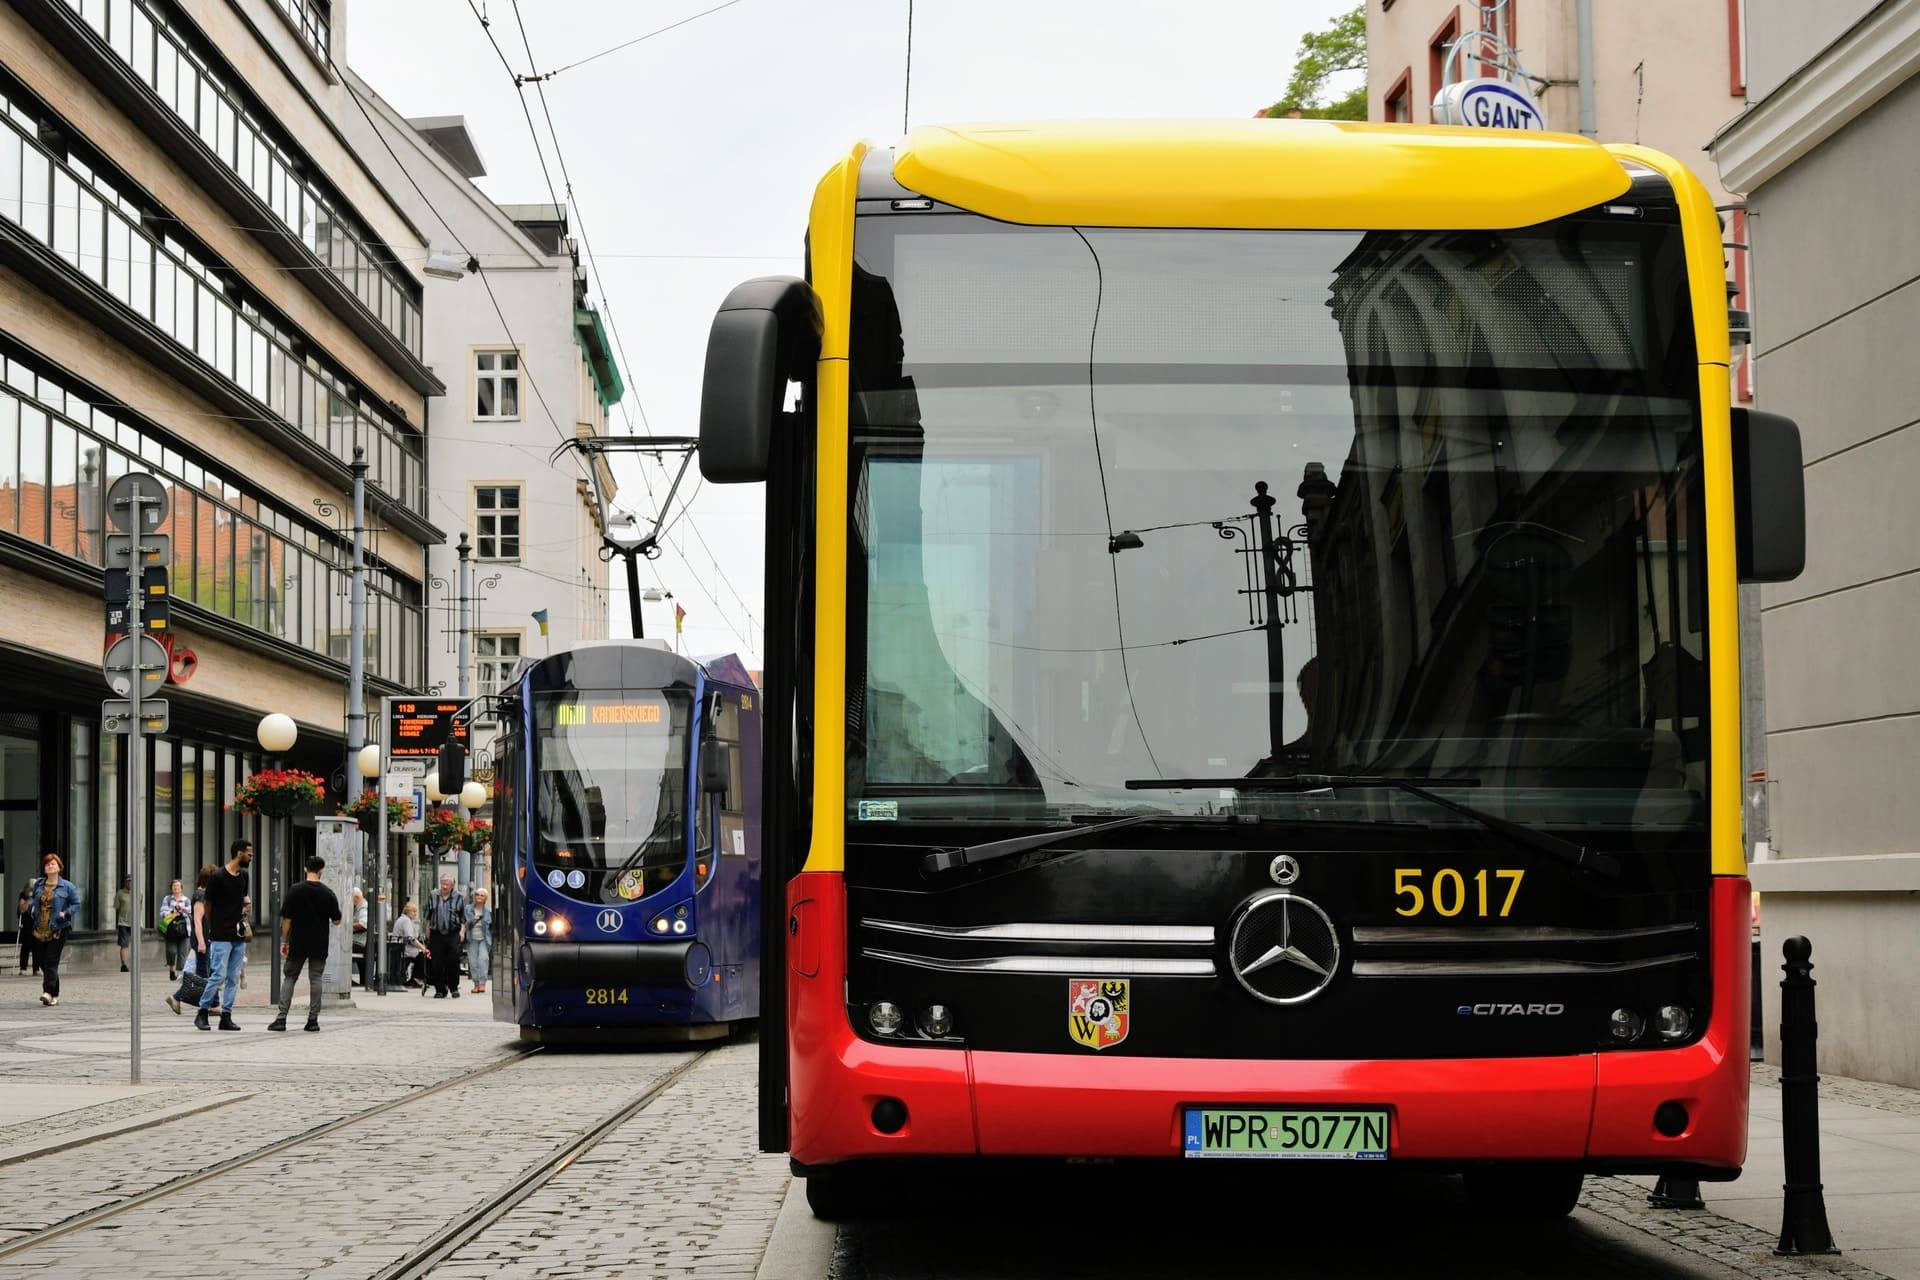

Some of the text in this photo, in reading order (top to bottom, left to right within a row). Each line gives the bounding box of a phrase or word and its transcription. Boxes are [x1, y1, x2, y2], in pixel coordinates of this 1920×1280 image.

[1475, 96, 1532, 130] GANT
[1395, 868, 1525, 917] 5017
[586, 988, 628, 1005] 2814
[1457, 1003, 1565, 1016] eCITARO
[1072, 1016, 1096, 1041] W
[1187, 1135, 1200, 1145] PL
[1204, 1114, 1384, 1150] WPR 5077N
